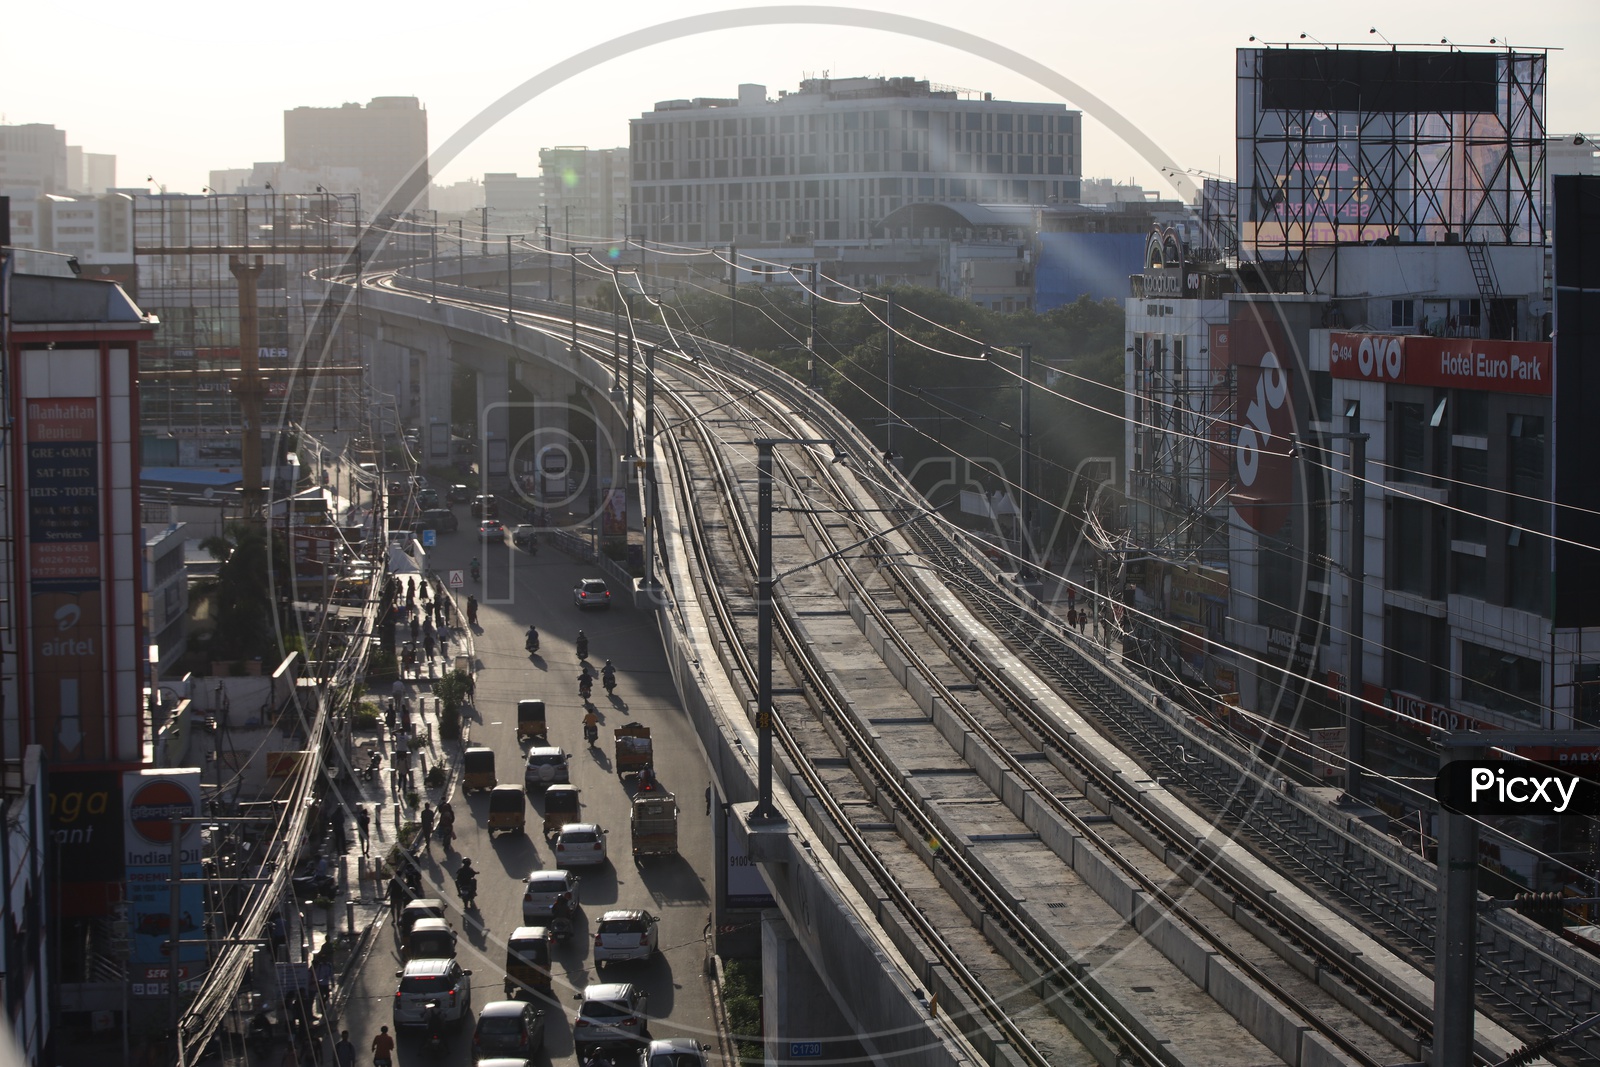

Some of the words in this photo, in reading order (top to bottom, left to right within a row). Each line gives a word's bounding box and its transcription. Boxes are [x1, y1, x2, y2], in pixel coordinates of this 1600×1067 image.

[1339, 346, 1352, 361] 494
[1357, 336, 1401, 379] OYO
[1441, 352, 1473, 377] Hotel
[1476, 354, 1508, 379] Euro
[1510, 355, 1542, 381] Park
[29, 403, 95, 419] Manhattan
[1237, 351, 1288, 487] OYO
[38, 424, 82, 439] Review
[32, 448, 55, 458] GRE
[61, 447, 94, 458] GMAT
[36, 468, 55, 477] SAT
[62, 467, 90, 477] IELTS
[30, 487, 58, 496] IELTS
[64, 487, 97, 496] TOEFL
[45, 531, 82, 539] Services
[31, 567, 56, 575] 9177
[42, 637, 95, 656] airtel
[1395, 696, 1427, 727] JUST
[1432, 707, 1459, 731] FOR
[730, 856, 748, 867] 9100
[146, 969, 184, 978] SERO
